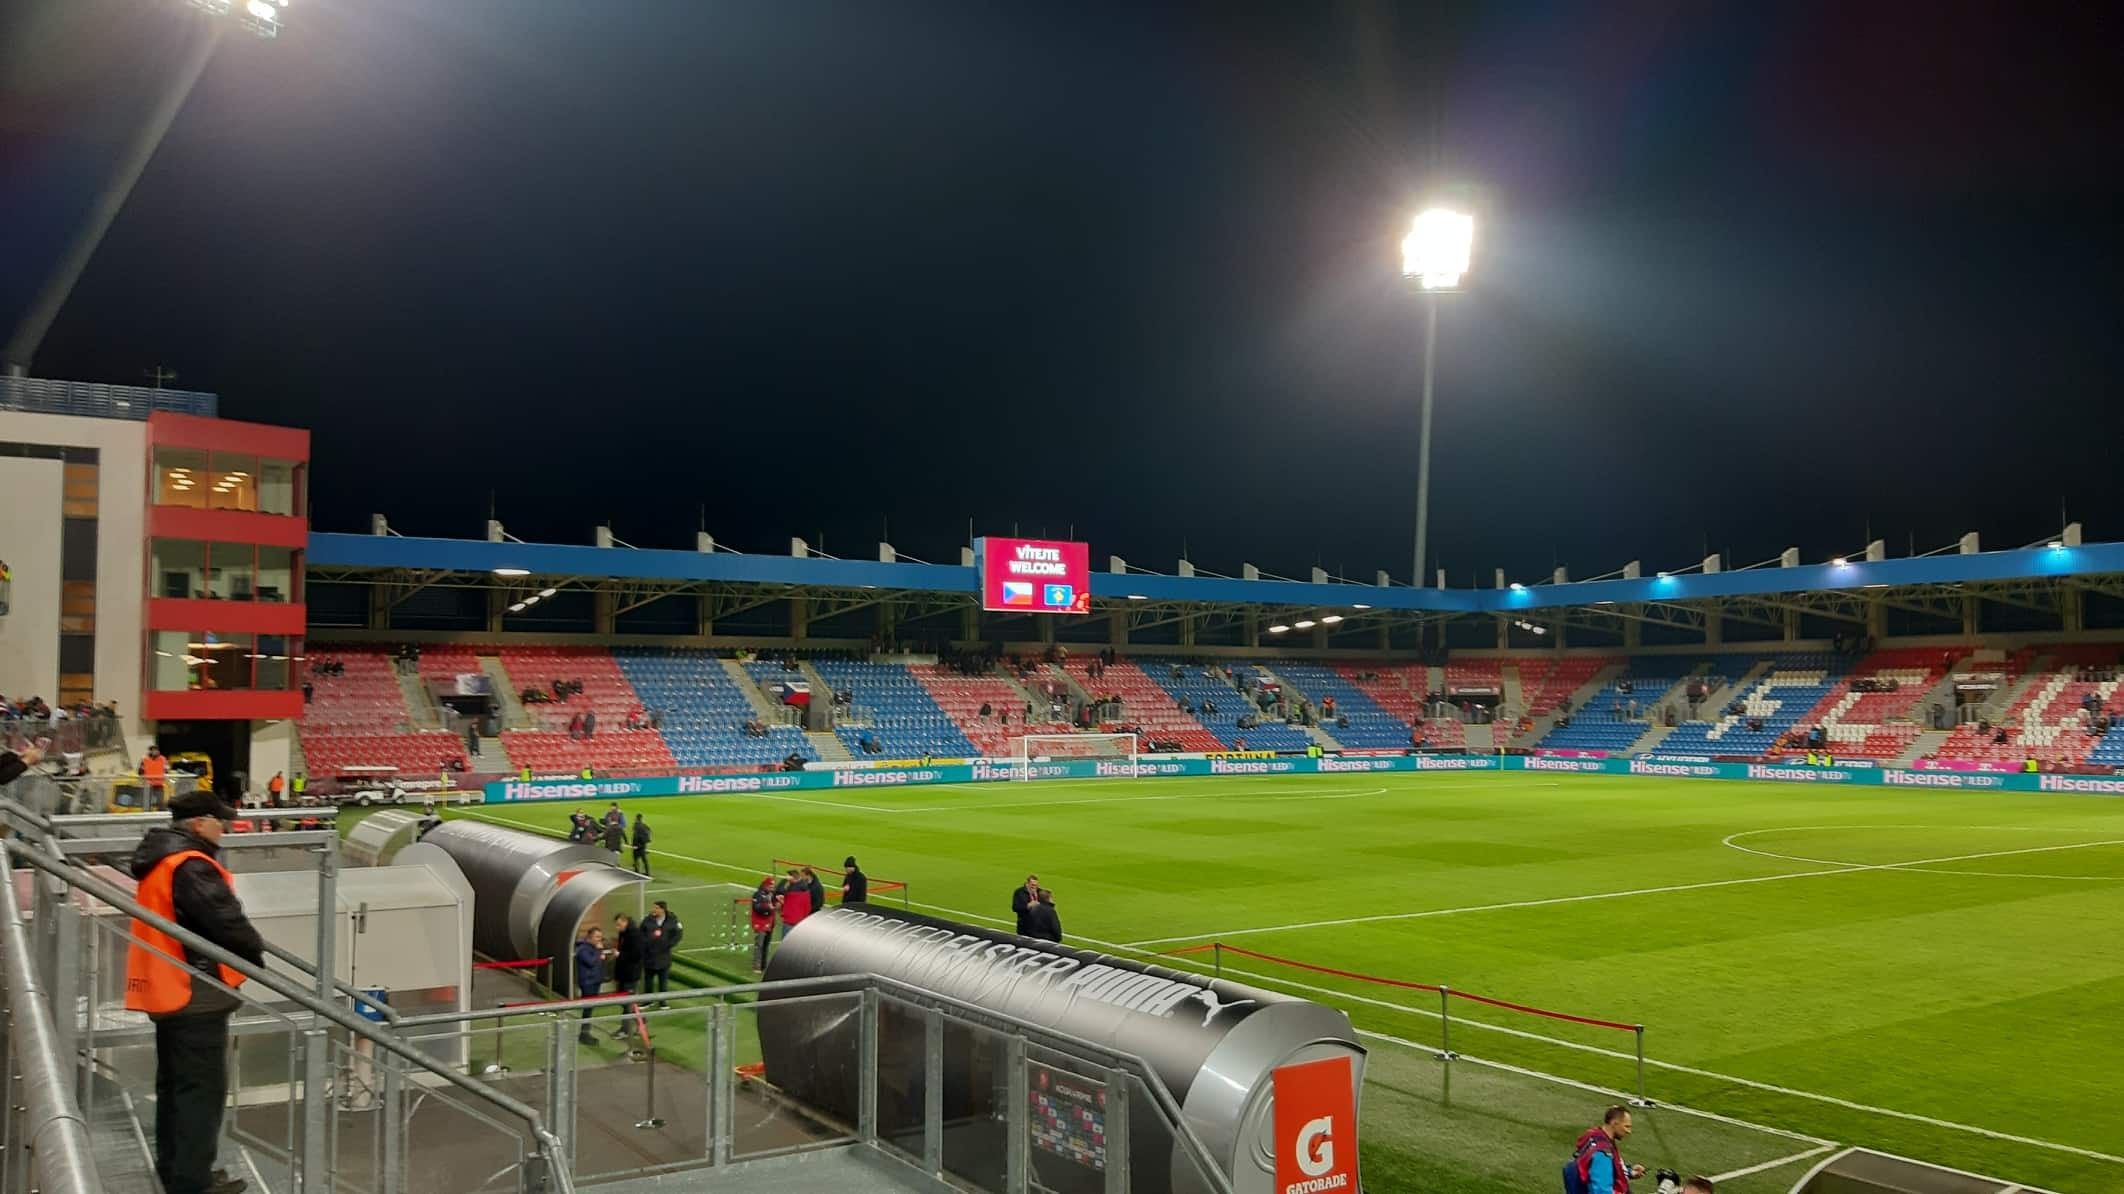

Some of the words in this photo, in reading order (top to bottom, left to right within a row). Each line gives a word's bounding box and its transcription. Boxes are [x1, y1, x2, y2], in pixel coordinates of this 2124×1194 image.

[1015, 544, 1060, 561] VÍTEJTE
[1009, 560, 1067, 575] WELCOME
[1096, 762, 1157, 775] Hisense
[1211, 760, 1268, 773] Hisense
[1317, 759, 1370, 771] Hisense
[1416, 757, 1467, 768] Hisense
[1524, 757, 1579, 770] Hisense
[1630, 760, 1690, 774] Hisense
[834, 771, 907, 786] Hisense
[972, 765, 1038, 779] Hisense
[1748, 766, 1817, 780] Hisense
[1883, 769, 1962, 786] Hisense
[504, 782, 598, 800] Hisense
[679, 776, 761, 792] Hisense
[2040, 775, 2124, 793] Hisense
[826, 908, 955, 946] FOREVER
[934, 934, 1081, 984] FASTER
[1055, 963, 1203, 1018] PUMA
[1295, 1115, 1334, 1174] G
[1286, 1173, 1348, 1194] GATORADE
